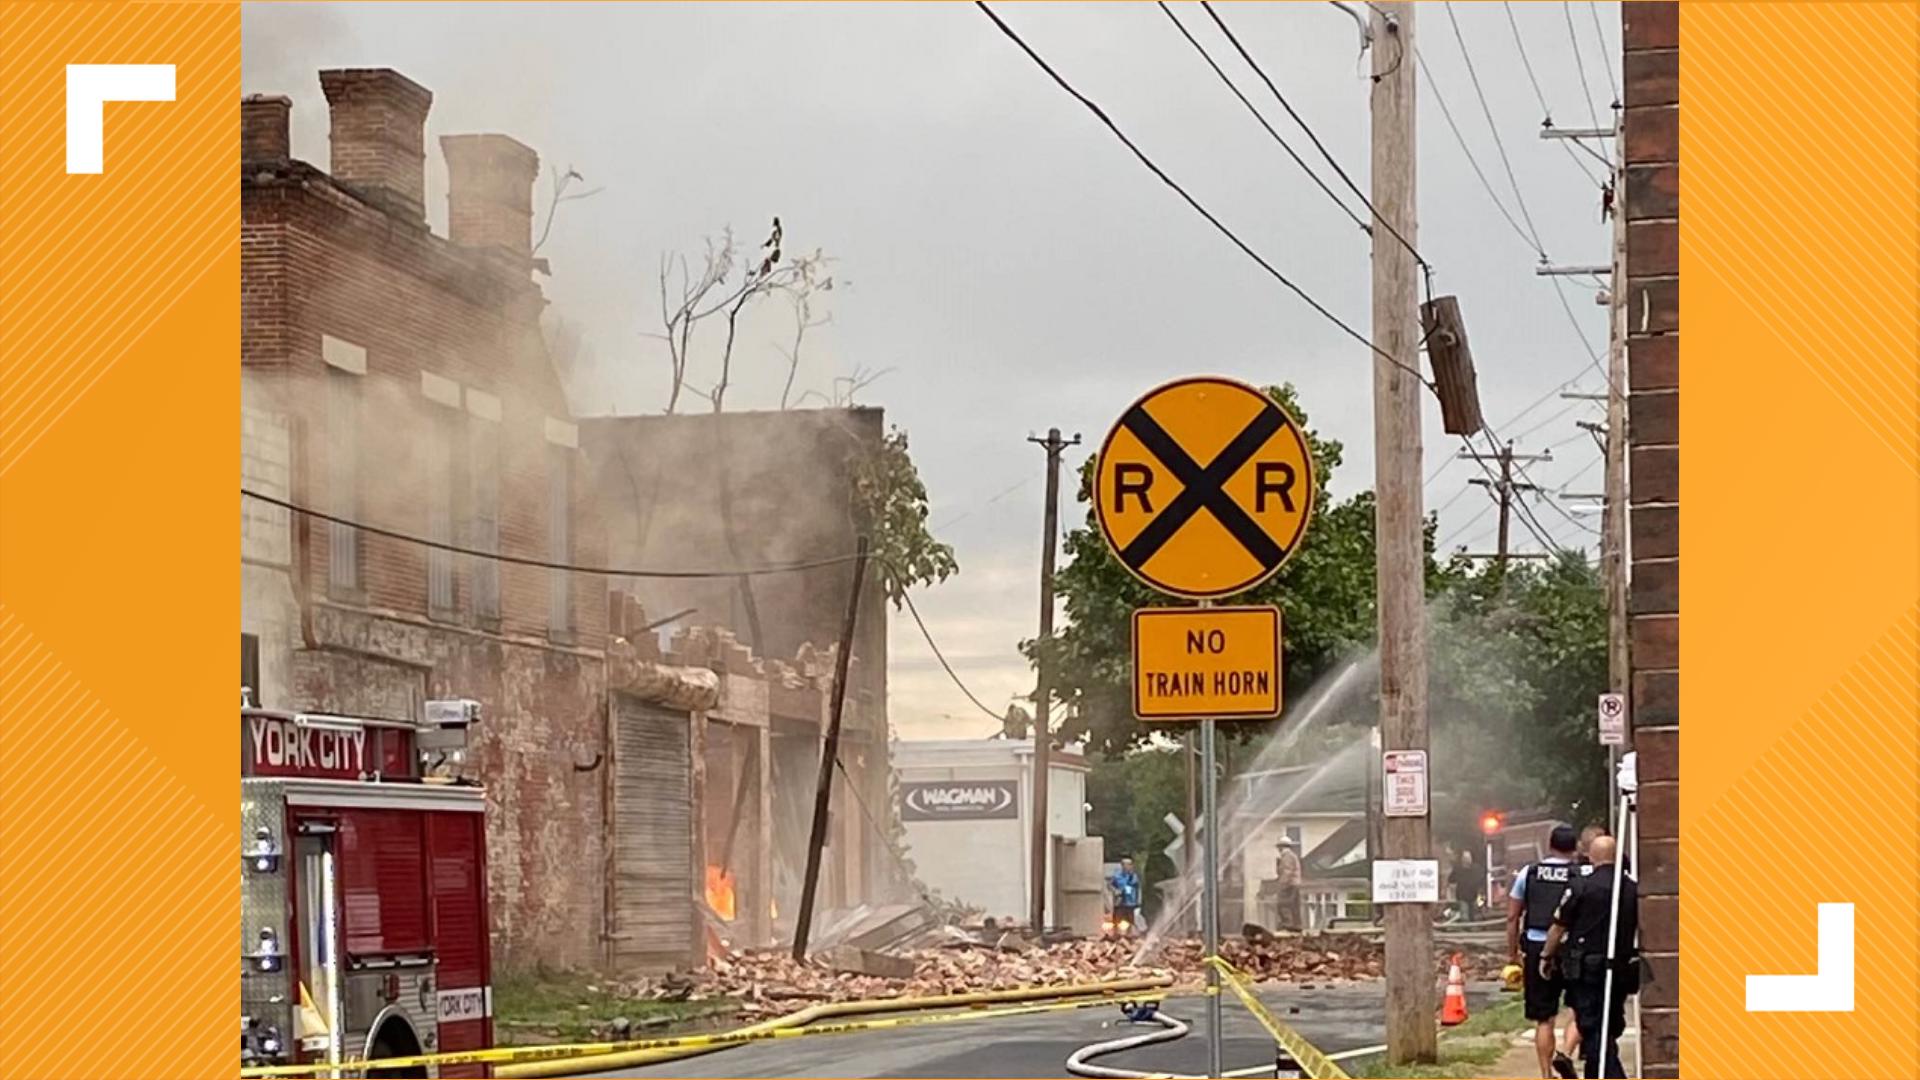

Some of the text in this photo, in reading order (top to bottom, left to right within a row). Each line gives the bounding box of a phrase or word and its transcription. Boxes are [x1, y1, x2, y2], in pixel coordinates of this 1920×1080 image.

[1114, 461, 1296, 514] R R
[1186, 629, 1226, 655] NO
[1146, 671, 1269, 697] TRAIN HORN
[250, 717, 366, 770] YORK CITY
[922, 787, 996, 805] WAGMAN
[1537, 865, 1569, 882] POLICE
